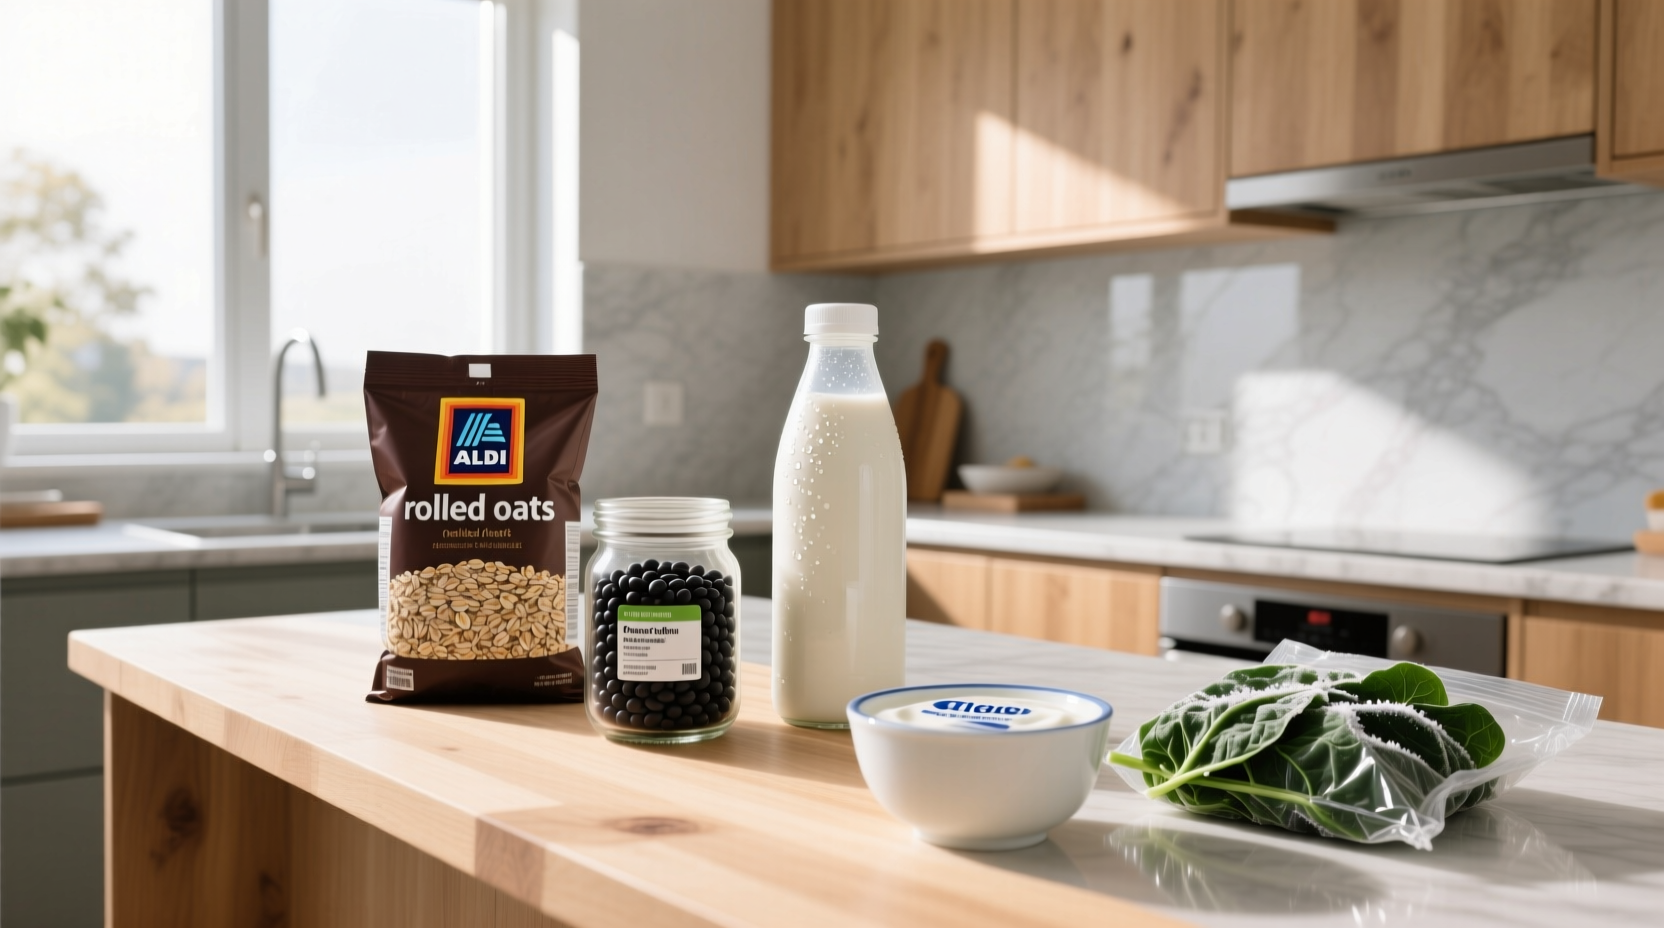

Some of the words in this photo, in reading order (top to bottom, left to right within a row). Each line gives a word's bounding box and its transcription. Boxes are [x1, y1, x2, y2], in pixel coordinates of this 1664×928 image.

[453, 450, 507, 466] ALDI
[404, 493, 486, 521] rolled
[493, 496, 556, 521] oats
